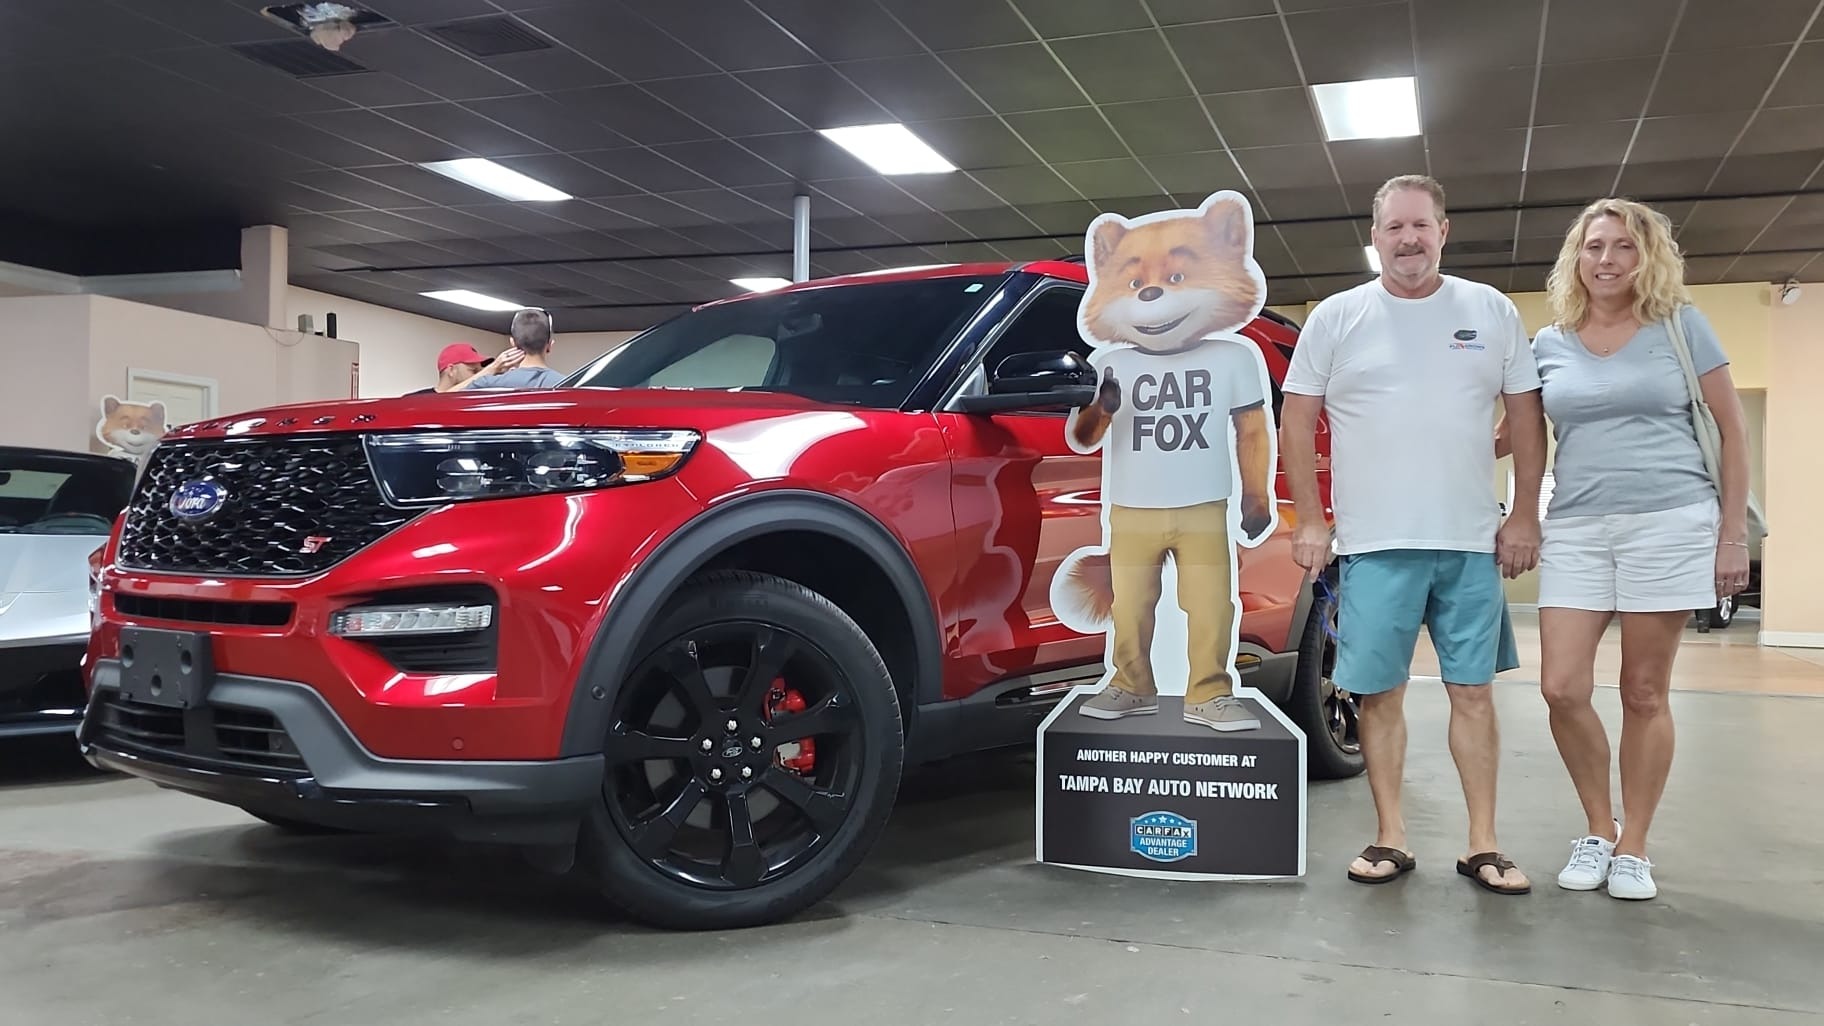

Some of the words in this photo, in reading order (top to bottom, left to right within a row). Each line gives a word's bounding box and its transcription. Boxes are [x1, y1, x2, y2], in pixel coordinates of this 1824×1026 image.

[1132, 369, 1212, 411] CAR
[1132, 413, 1210, 451] FOX
[299, 535, 332, 553] ST
[1076, 749, 1127, 763] ANOTHER
[1130, 751, 1170, 765] HAPPY
[1172, 753, 1239, 767] CUSTOMER
[1241, 755, 1257, 768] AT
[1059, 775, 1109, 793] TAMPA
[1113, 777, 1143, 794] BAY
[1147, 779, 1191, 797] AUTO
[1196, 781, 1279, 800] NETWORK
[1136, 826, 1191, 838] CARFAX
[1140, 837, 1188, 848] ADVANTAGE
[1147, 846, 1179, 856] DEALER
